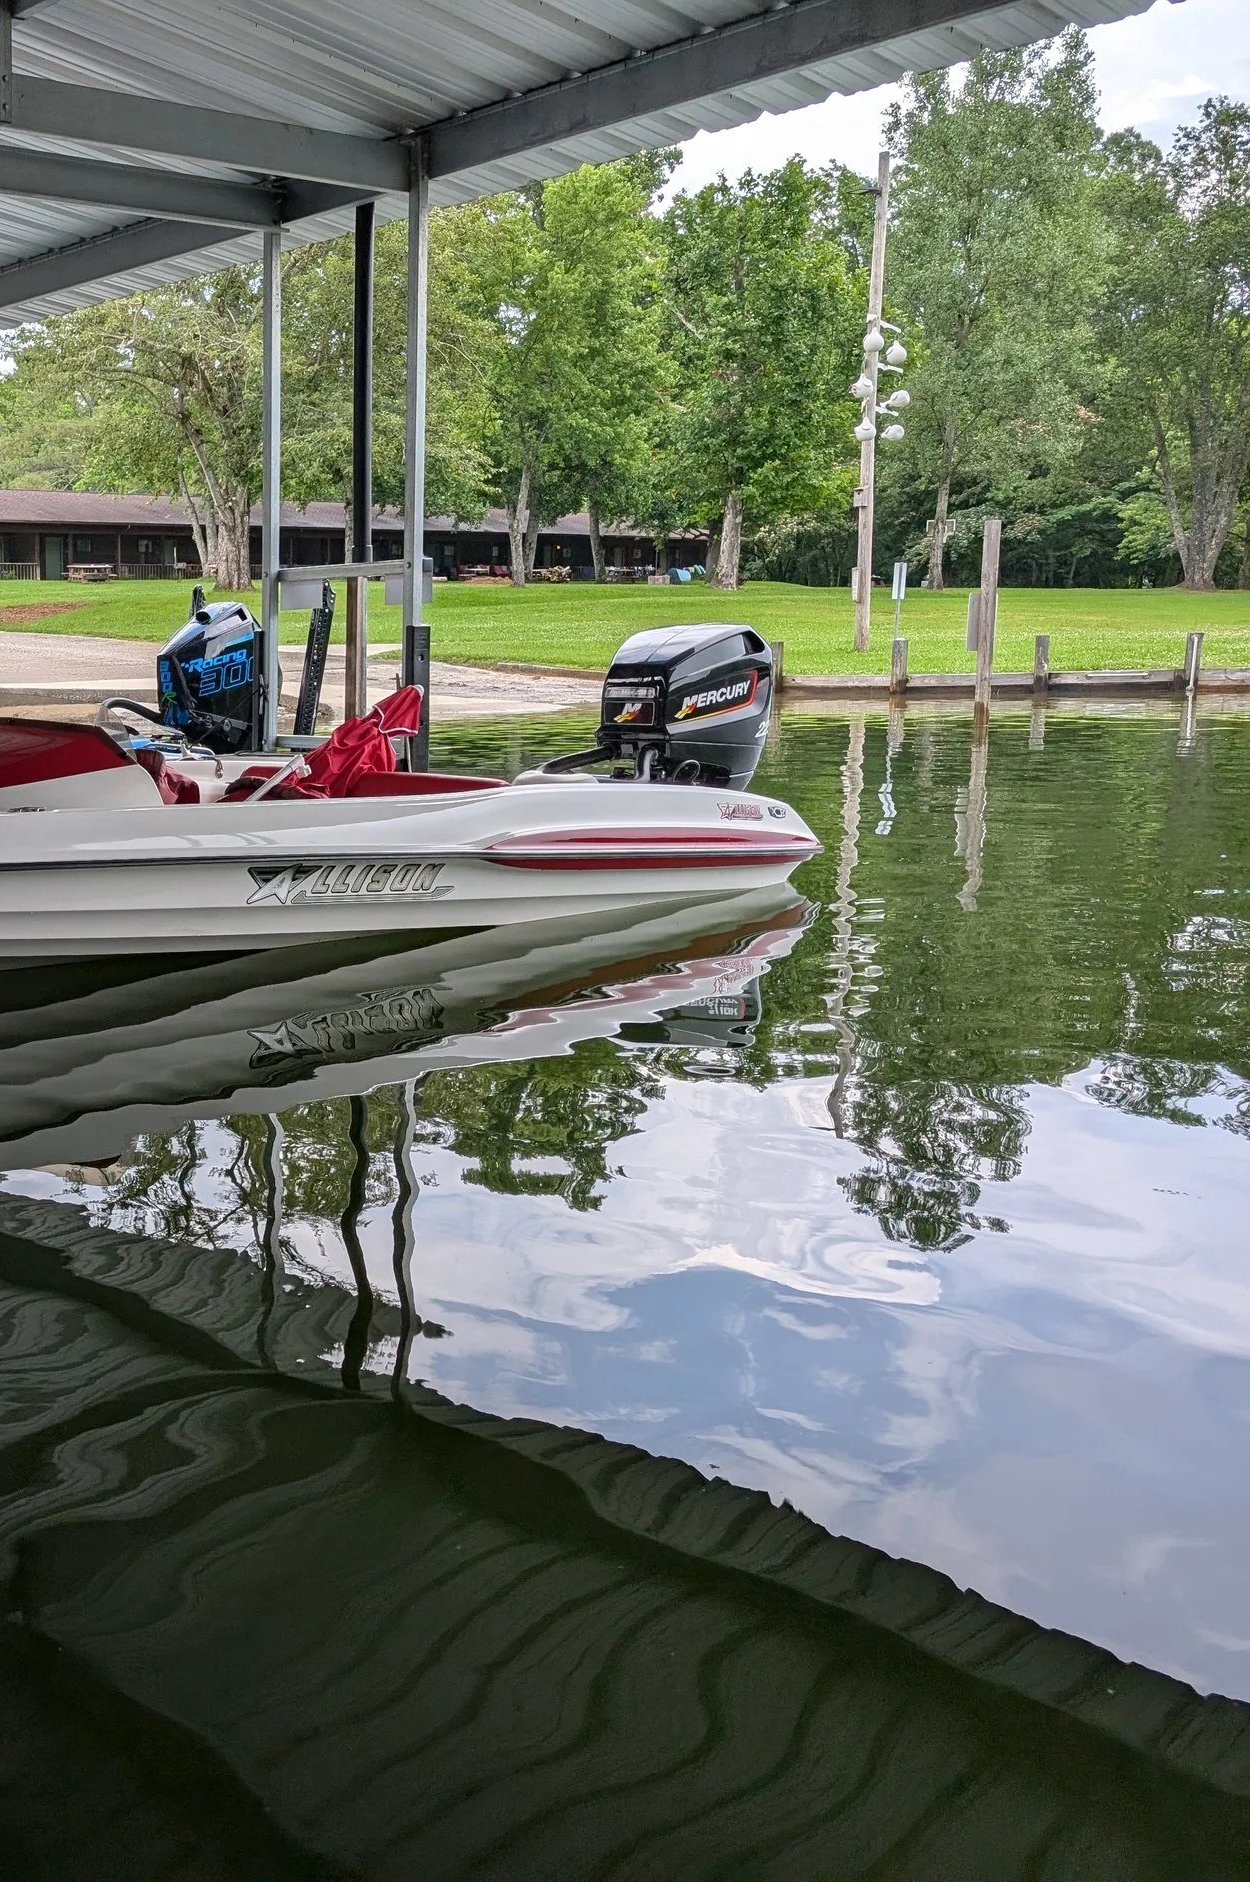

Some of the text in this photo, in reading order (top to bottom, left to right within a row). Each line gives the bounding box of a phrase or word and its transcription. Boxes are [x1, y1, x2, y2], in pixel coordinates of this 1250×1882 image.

[188, 649, 247, 672] Racing
[199, 655, 254, 697] 30
[681, 680, 751, 712] MERCURY
[247, 863, 446, 904] ALLISON
